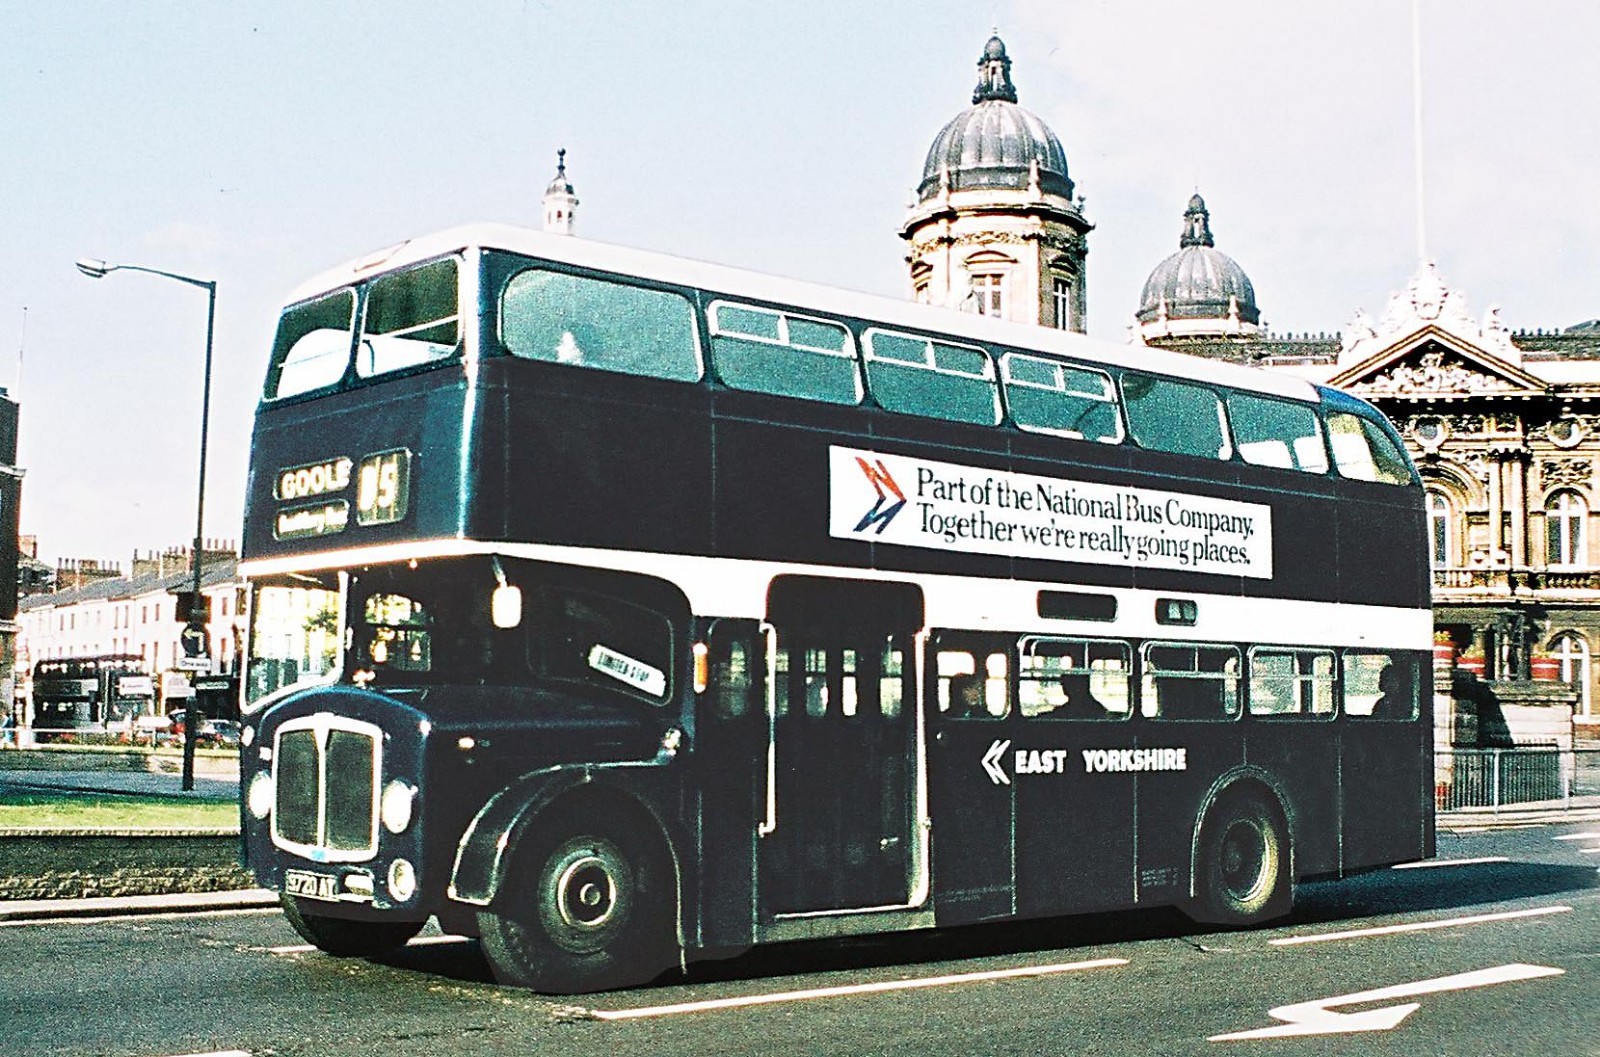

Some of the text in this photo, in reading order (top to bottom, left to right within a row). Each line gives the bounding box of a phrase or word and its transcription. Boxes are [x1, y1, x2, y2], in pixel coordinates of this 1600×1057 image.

[916, 502, 1251, 566] Together we're really going places.
[917, 467, 1254, 541] Part of the National Bus Company.
[1015, 748, 1187, 773] EAST YORKSHIRE
